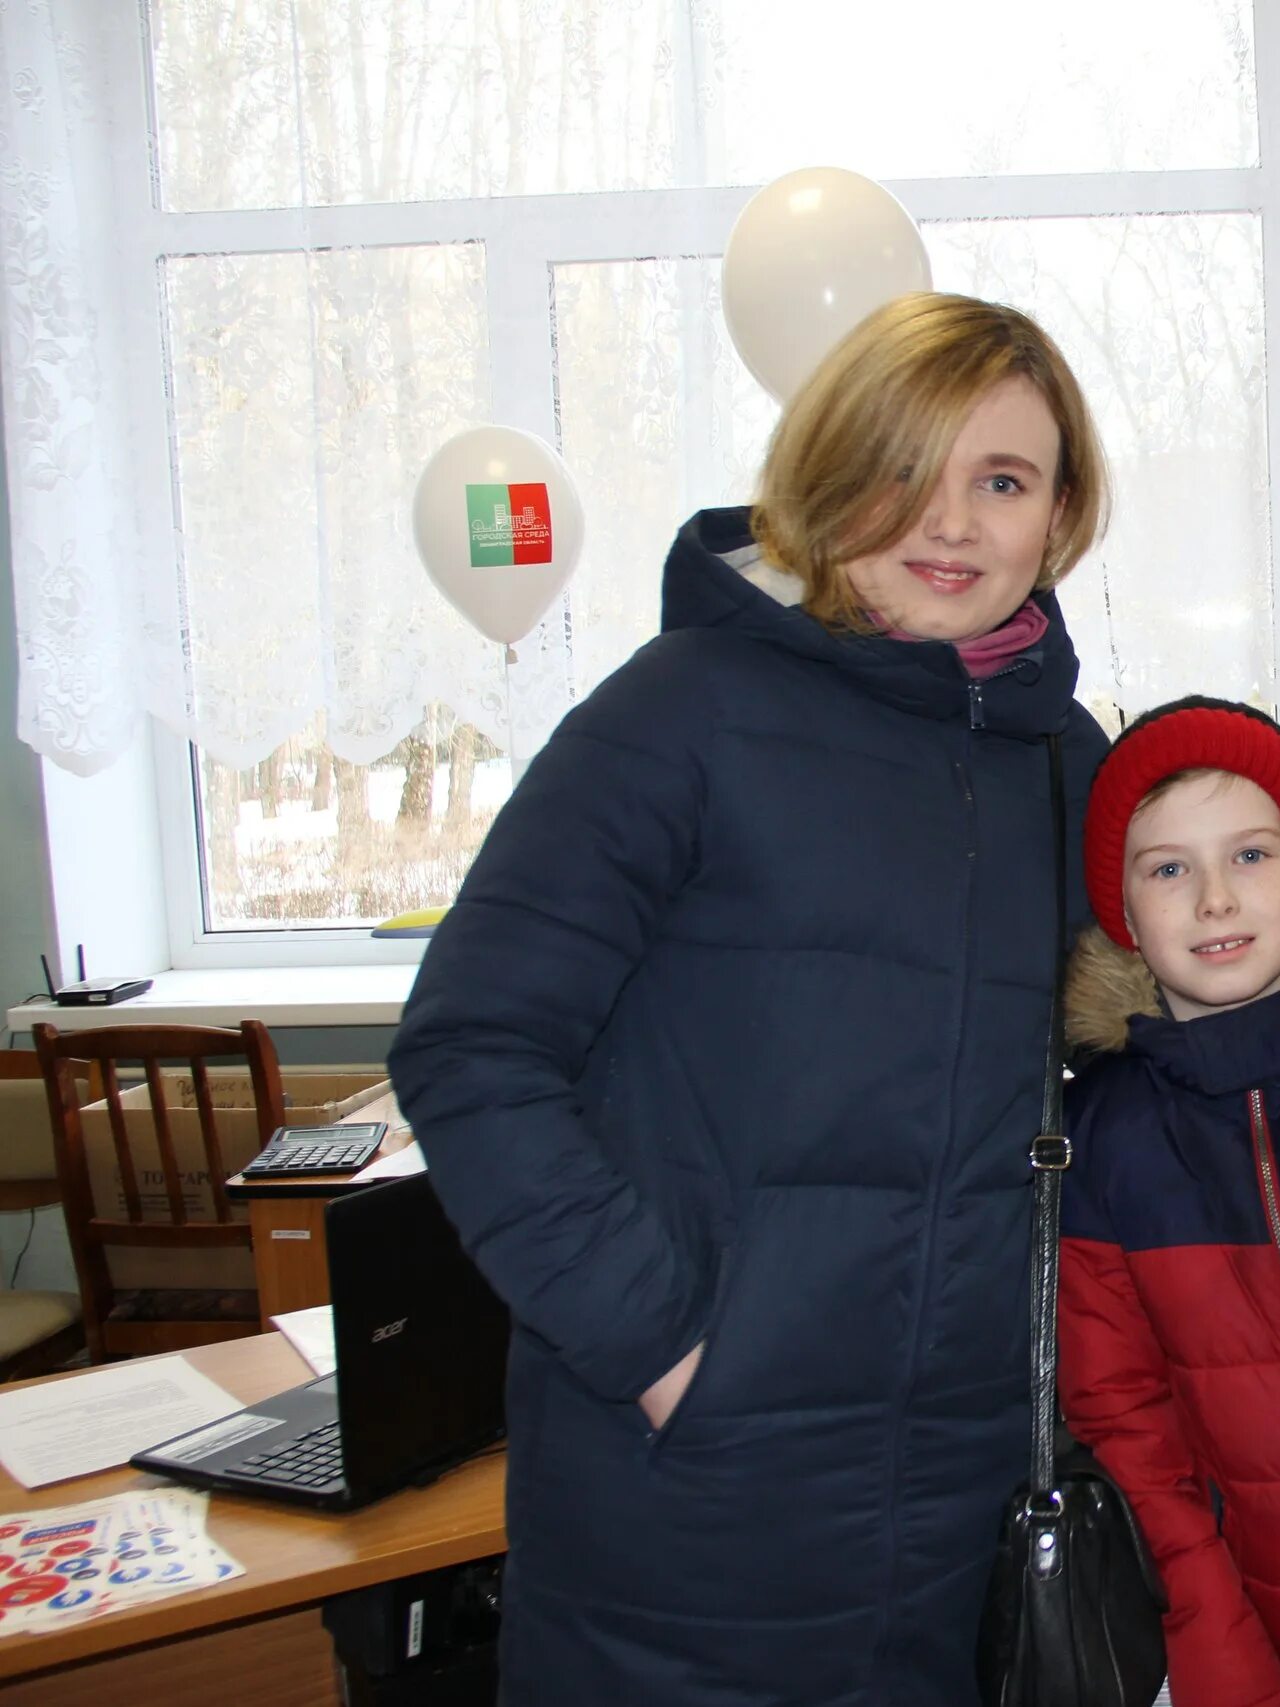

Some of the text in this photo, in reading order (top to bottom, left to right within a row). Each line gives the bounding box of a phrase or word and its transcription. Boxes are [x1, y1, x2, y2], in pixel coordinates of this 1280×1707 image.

[472, 530, 550, 540] ГОРОДСКАЯ СРЕДА
[371, 1317, 409, 1343] acer
